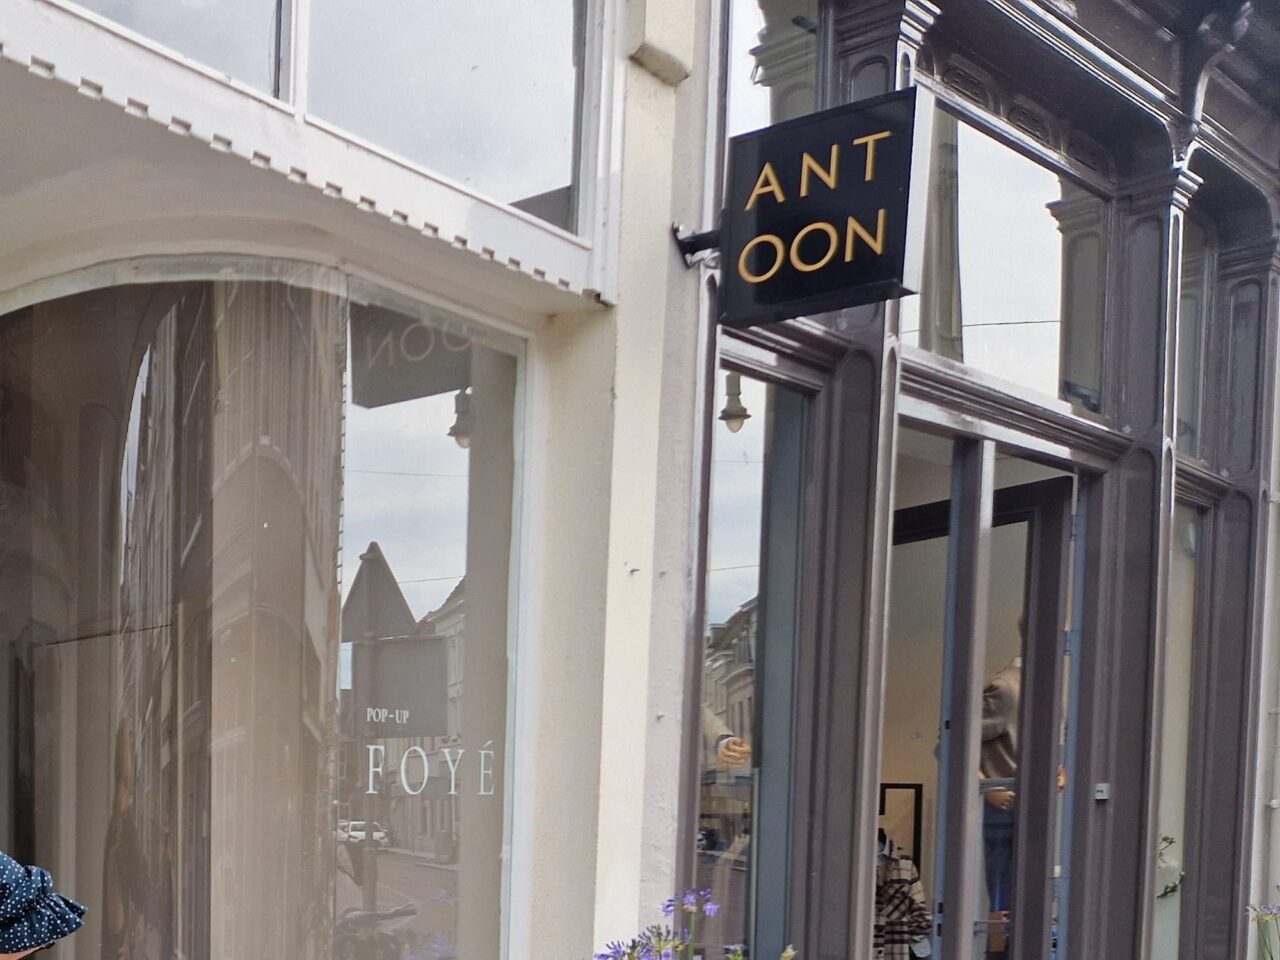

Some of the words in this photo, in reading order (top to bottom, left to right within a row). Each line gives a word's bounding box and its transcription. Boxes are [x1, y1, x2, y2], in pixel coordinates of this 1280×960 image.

[744, 131, 893, 212] ANT
[738, 208, 887, 284] OON
[366, 707, 410, 724] POP-UP
[365, 740, 495, 795] FOYÉ
